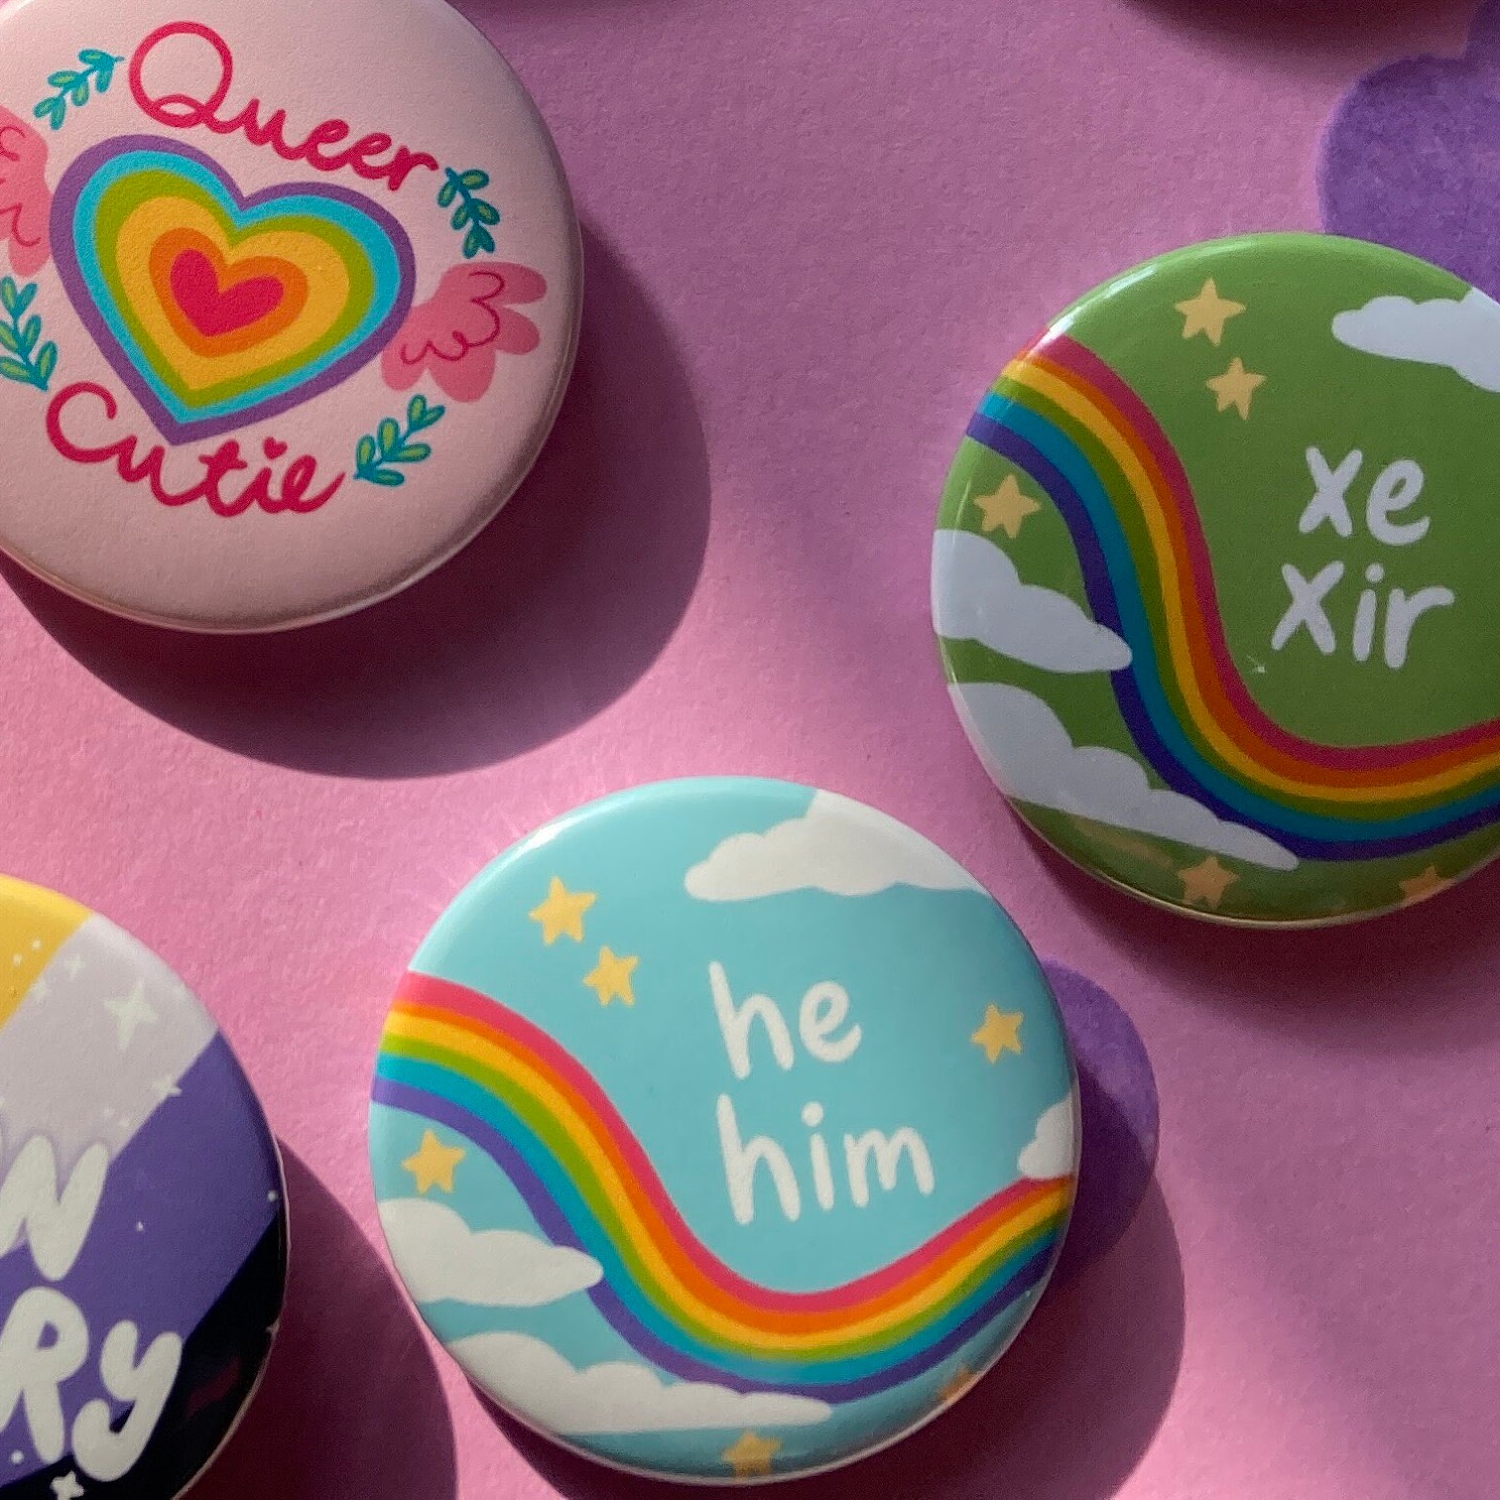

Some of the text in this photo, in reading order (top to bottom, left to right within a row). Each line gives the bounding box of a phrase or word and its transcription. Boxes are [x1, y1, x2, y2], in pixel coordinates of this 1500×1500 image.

[129, 22, 438, 191] Queer
[47, 382, 348, 517] Cutie
[709, 960, 863, 1080] he
[716, 1093, 934, 1226] him
